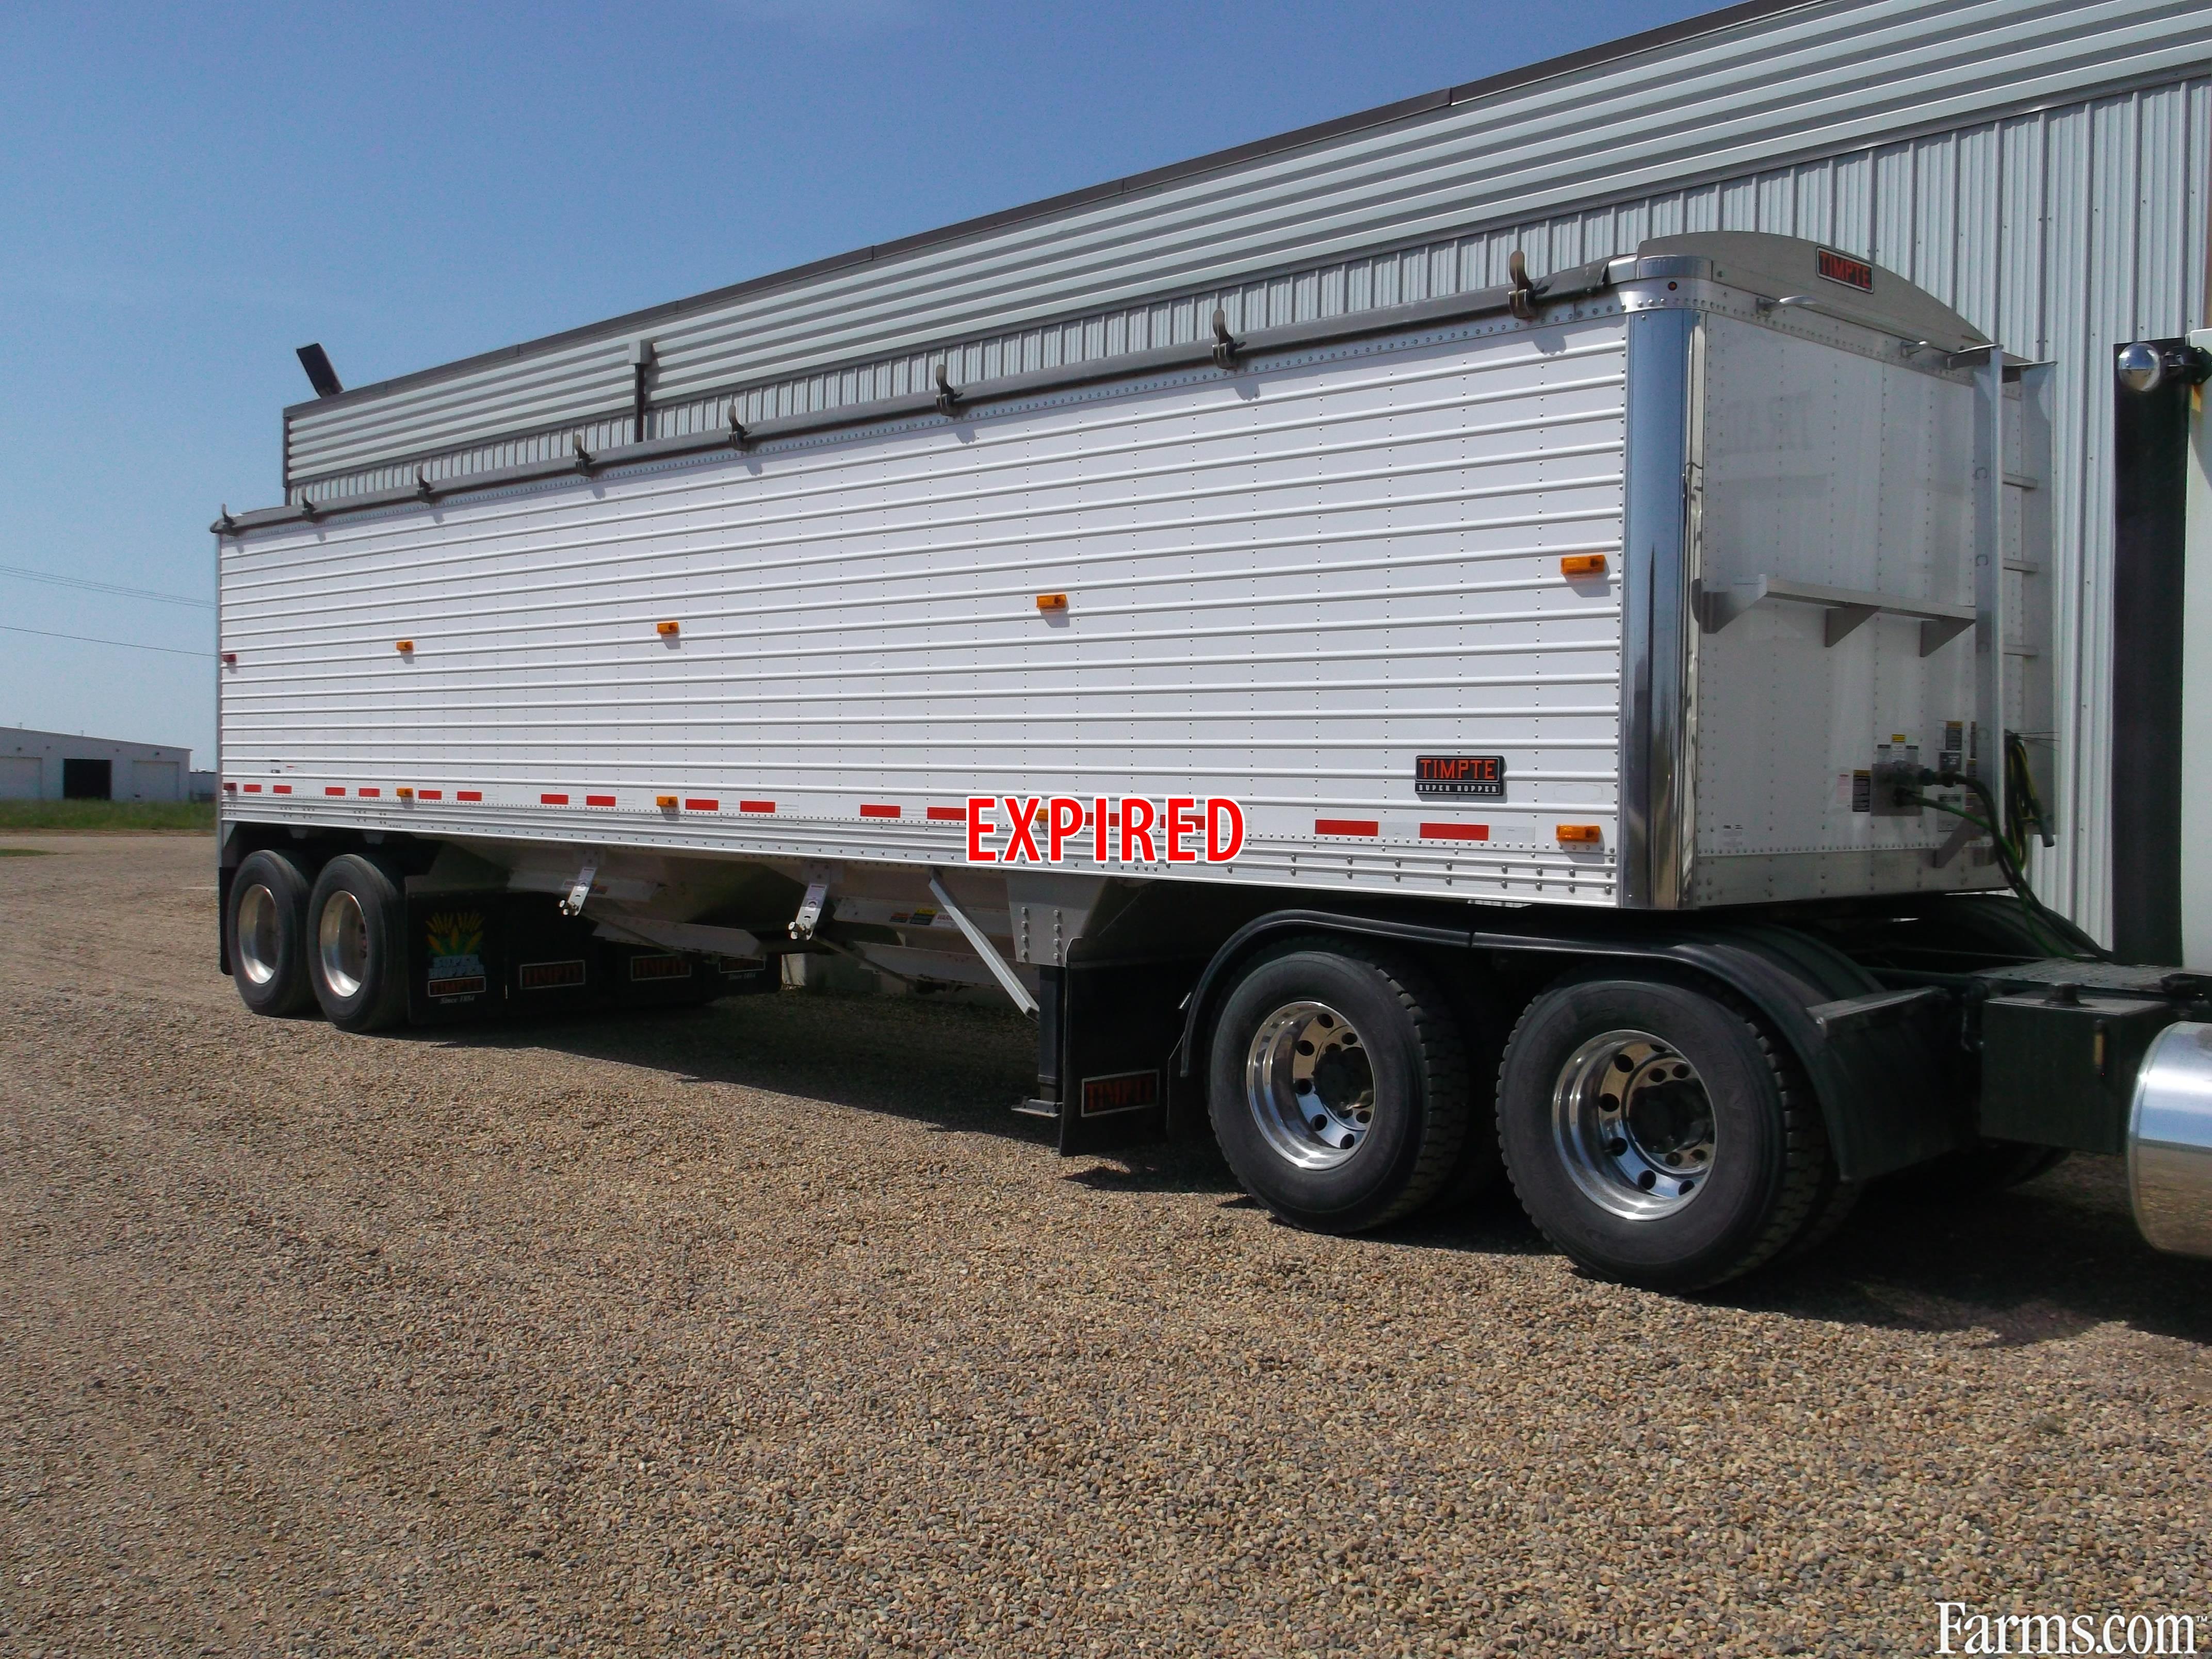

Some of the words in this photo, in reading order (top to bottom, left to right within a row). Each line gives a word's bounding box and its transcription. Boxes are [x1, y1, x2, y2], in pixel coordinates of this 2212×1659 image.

[1819, 251, 1872, 289] TIMPTE
[1420, 759, 1495, 780] TIMPTE
[1457, 785, 1497, 793] HOPPER
